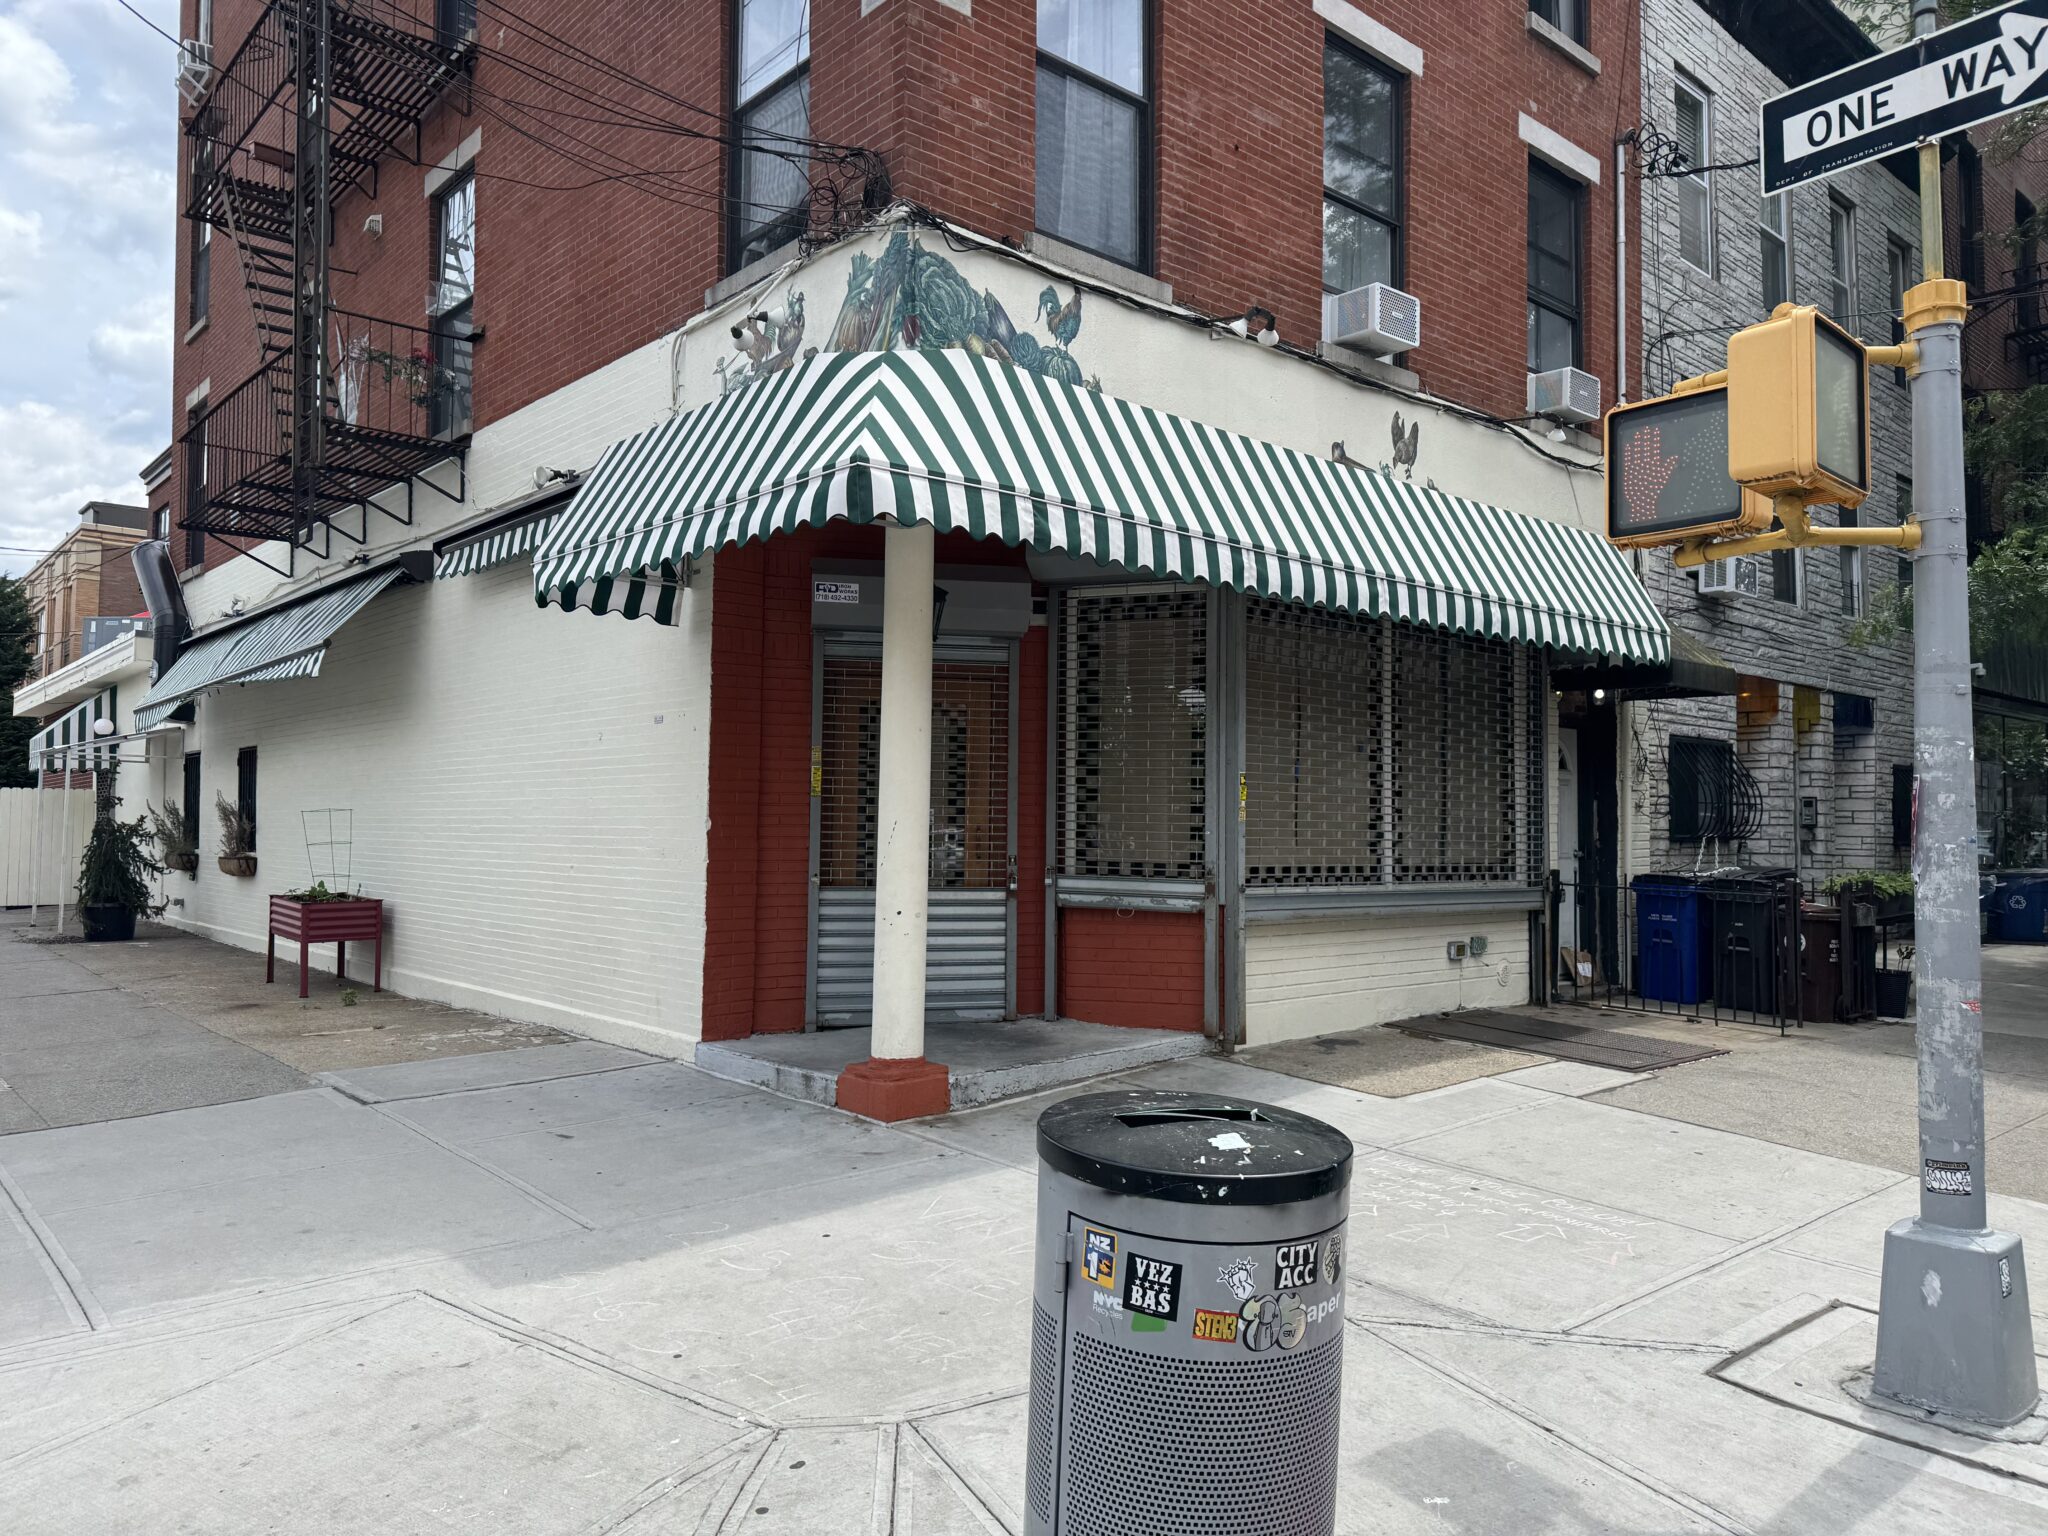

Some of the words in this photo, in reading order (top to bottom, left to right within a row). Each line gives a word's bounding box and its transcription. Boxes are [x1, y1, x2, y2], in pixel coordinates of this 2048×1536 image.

[1806, 84, 1896, 147] ONE
[1942, 24, 2048, 99] WAY
[1775, 176, 1795, 187] DEPT
[1821, 142, 1893, 170] TRANSPORTATION
[830, 594, 858, 602] 492-4330
[1276, 1241, 1319, 1268] CITY
[1135, 1257, 1174, 1285] VEZ
[1278, 1263, 1314, 1289] ACC
[1093, 1290, 1123, 1311] NYC
[1130, 1285, 1171, 1313] BAS
